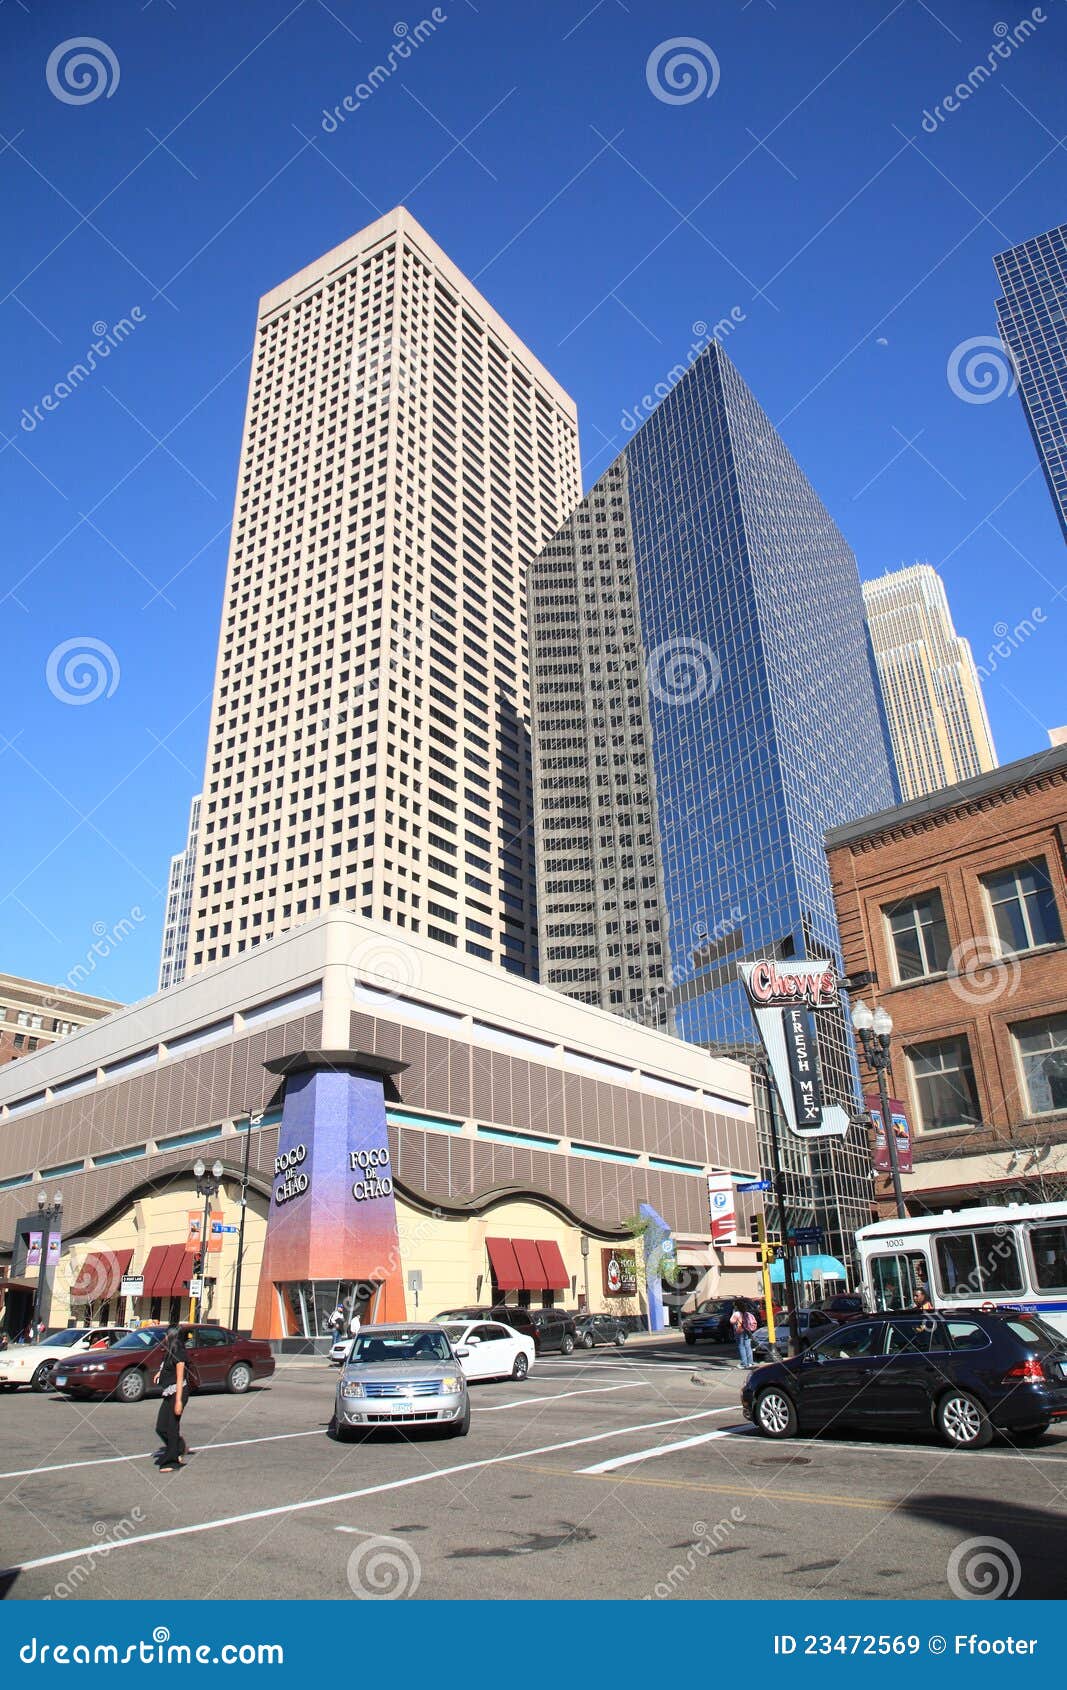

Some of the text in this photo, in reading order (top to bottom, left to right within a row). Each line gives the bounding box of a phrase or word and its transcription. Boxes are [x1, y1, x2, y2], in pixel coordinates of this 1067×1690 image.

[751, 961, 835, 1003] Chevys
[791, 1010, 818, 1119] FRESH MEX
[274, 1143, 306, 1174] FOGO
[350, 1147, 390, 1168] FOGO
[285, 1167, 297, 1180] DE
[365, 1168, 377, 1179] DE
